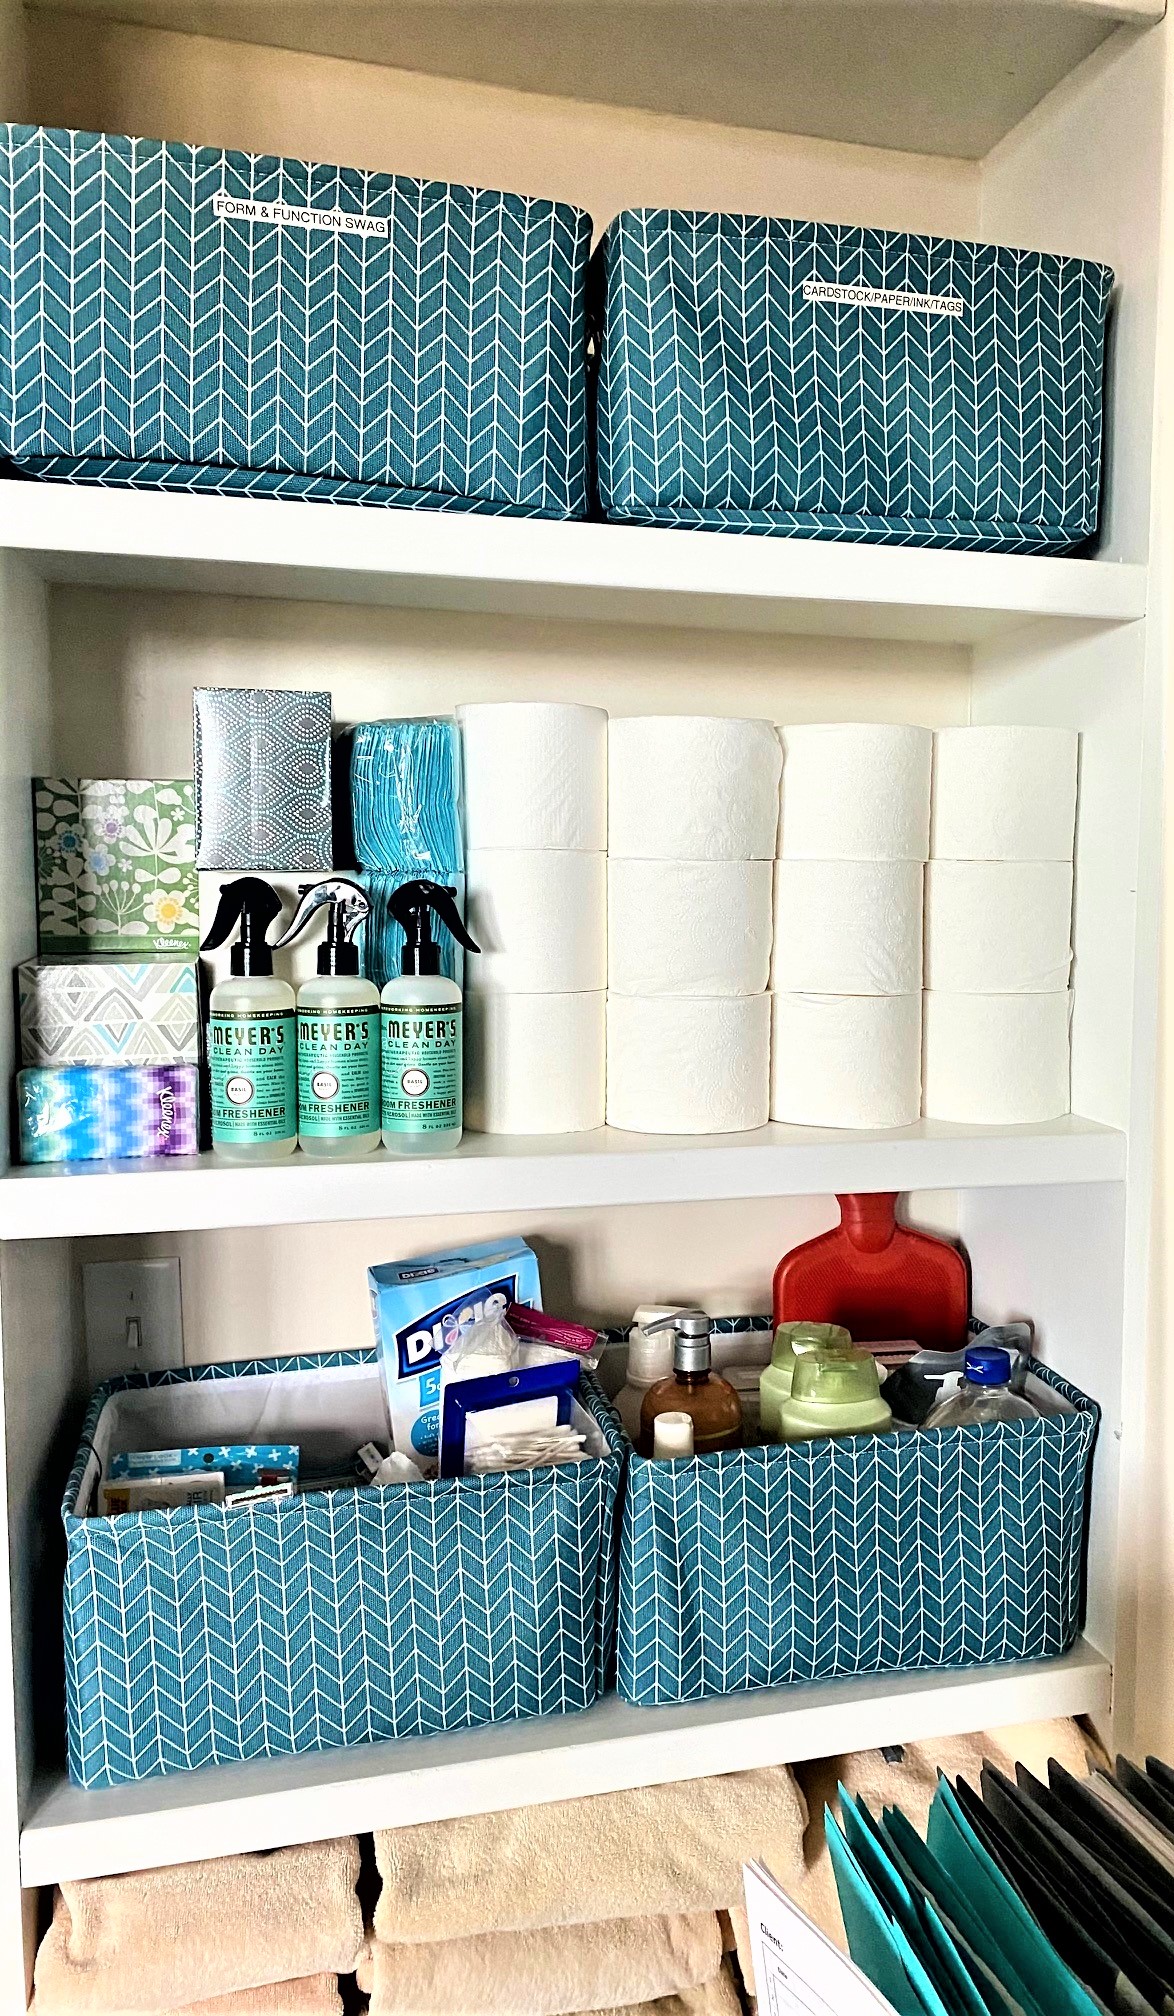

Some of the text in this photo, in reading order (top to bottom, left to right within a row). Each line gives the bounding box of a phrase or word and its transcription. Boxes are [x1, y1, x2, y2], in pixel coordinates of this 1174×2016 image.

[216, 200, 386, 233] FORM & FUNCTION SWAG
[803, 284, 963, 312] CARDSTOCK/PAPER/INK/TAGS
[153, 937, 189, 949] Kleenex
[213, 1025, 284, 1046] MEYER'S
[300, 1021, 369, 1041] MEYER'S
[388, 1019, 456, 1039] MEYER'S
[213, 1046, 284, 1056] CLEAN DAY
[299, 1042, 368, 1051] CLEAN DAY
[387, 1040, 456, 1049] CLEAN DAY
[156, 1085, 175, 1138] Kleenex
[308, 1101, 369, 1113] FRESHENER
[398, 1098, 457, 1110] FRESHENER
[222, 1106, 286, 1119] FRESHENER
[760, 1922, 784, 1952] Client:
